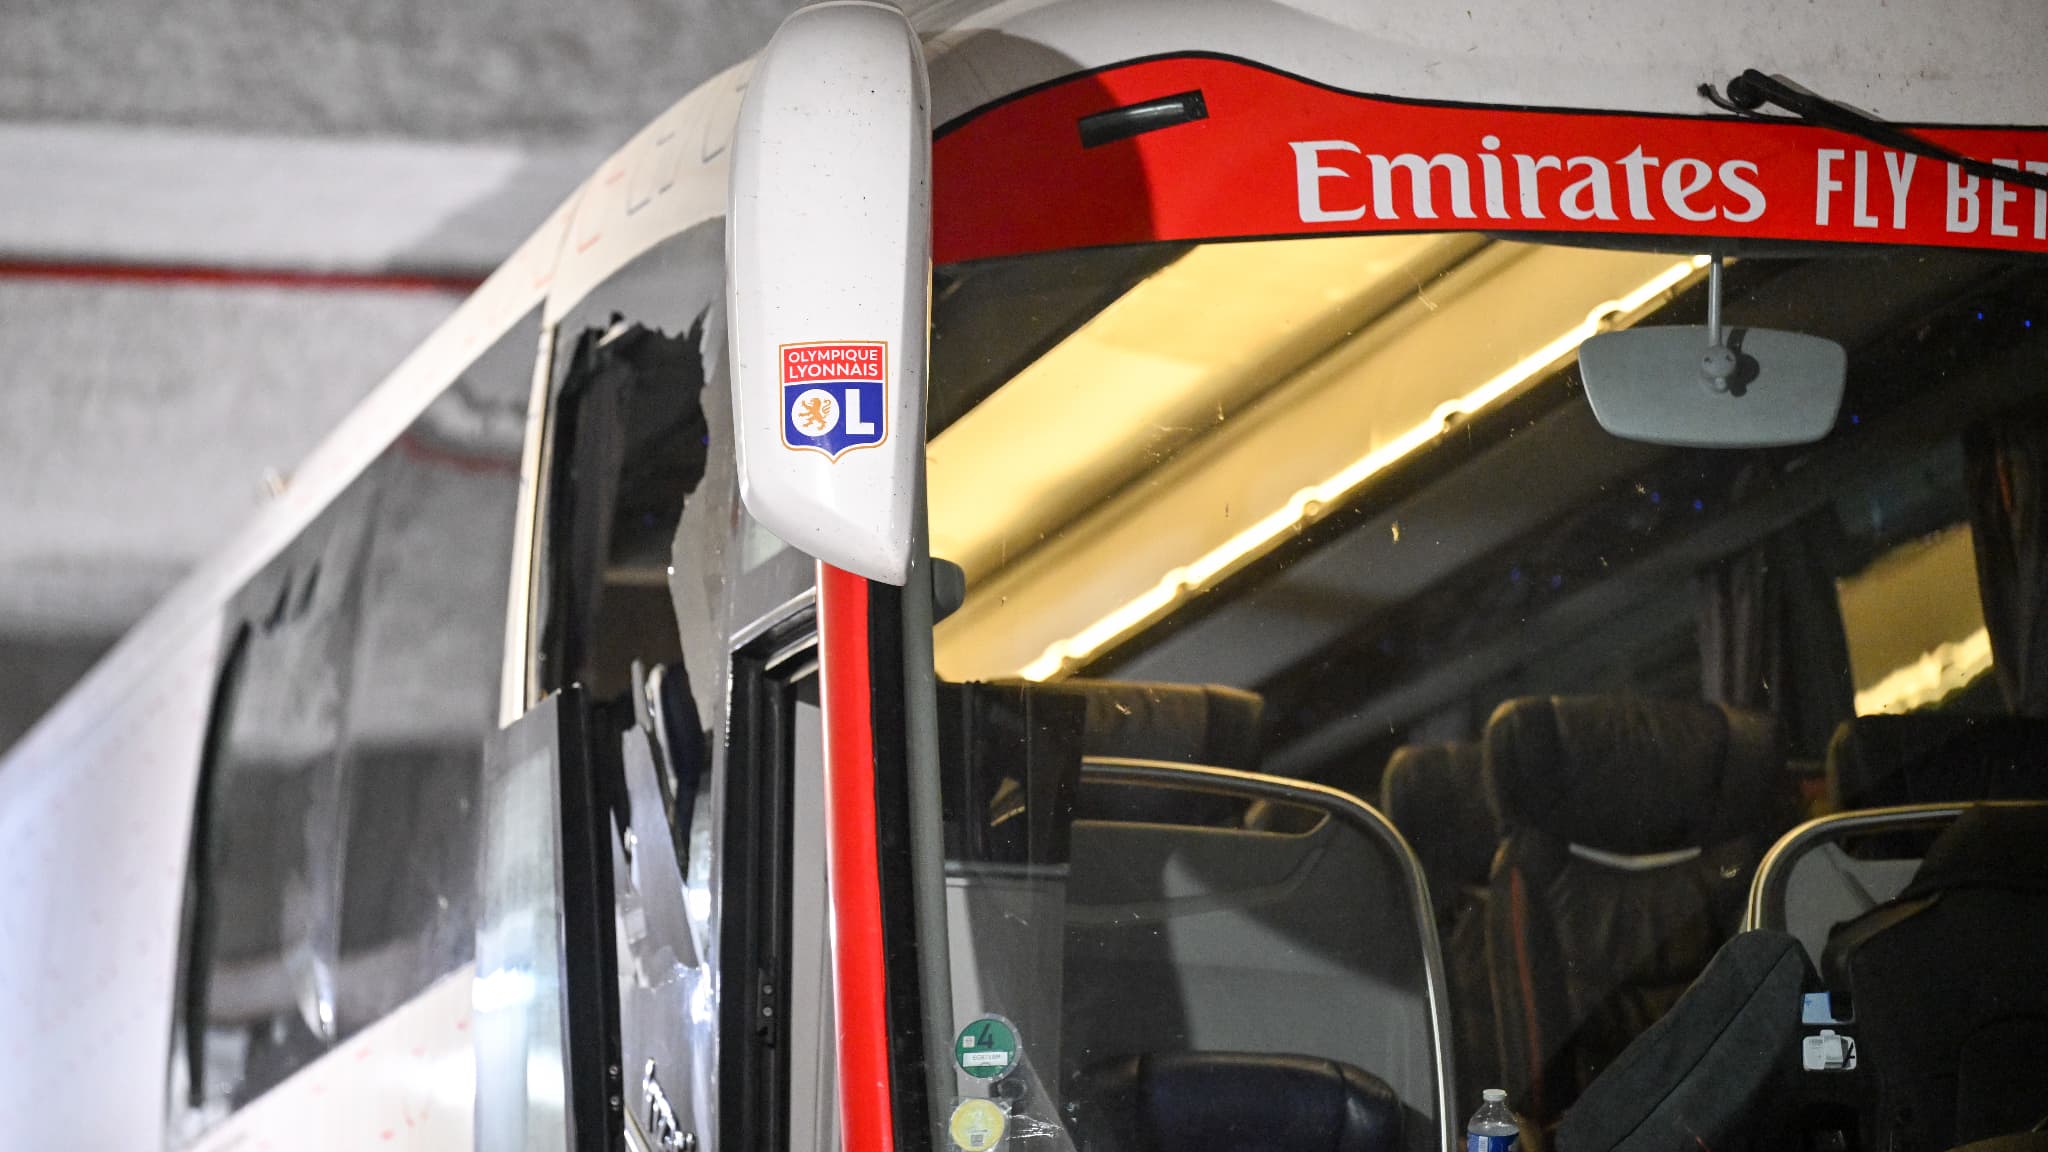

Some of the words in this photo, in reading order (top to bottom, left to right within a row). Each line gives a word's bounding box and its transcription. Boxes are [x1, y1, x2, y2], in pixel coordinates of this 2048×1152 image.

[1289, 135, 1767, 223] Emirates
[1815, 148, 1918, 230] FLY
[788, 349, 878, 363] OLYMPIQUE
[789, 363, 878, 379] LYONNAIS
[977, 1022, 994, 1049] 4
